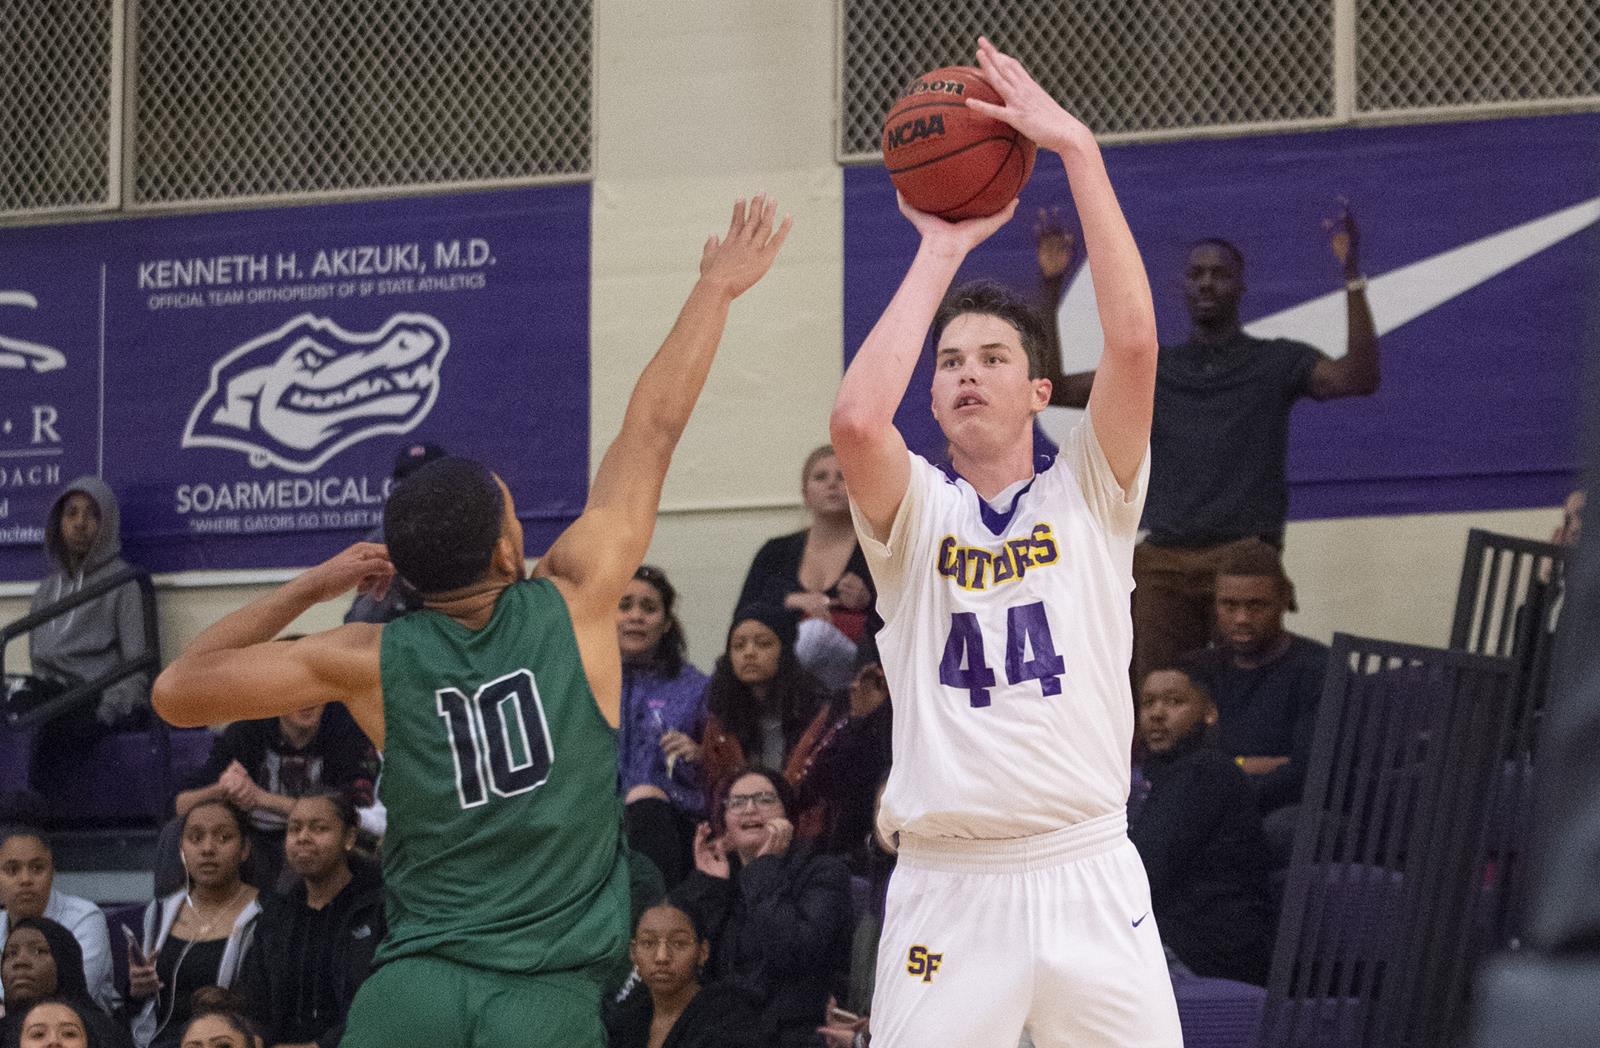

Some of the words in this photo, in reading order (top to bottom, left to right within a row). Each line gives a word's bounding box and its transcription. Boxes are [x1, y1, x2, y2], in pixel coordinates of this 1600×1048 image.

[888, 113, 945, 151] NCAA
[138, 254, 268, 289] KENNETH
[275, 253, 303, 281] H.
[311, 243, 427, 278] AKIZUKI,
[433, 238, 497, 270] M.D.
[148, 292, 206, 310] OFFICIAL
[208, 289, 245, 306] TEAM
[247, 283, 335, 303] ORTHOPEDIST
[337, 281, 356, 298] OF
[359, 279, 375, 296] SF
[376, 277, 416, 295] STATE
[417, 272, 487, 292] ATHLETICS
[31, 405, 61, 443] R
[175, 476, 394, 514] SOARMEDICAL.C
[243, 514, 296, 531] GATORS
[299, 512, 320, 528] GO
[322, 511, 342, 526] TO
[343, 509, 371, 525] GET
[937, 521, 1061, 592] GATORS
[938, 600, 1066, 709] 44
[434, 667, 555, 811] 10
[906, 944, 944, 984] SF
